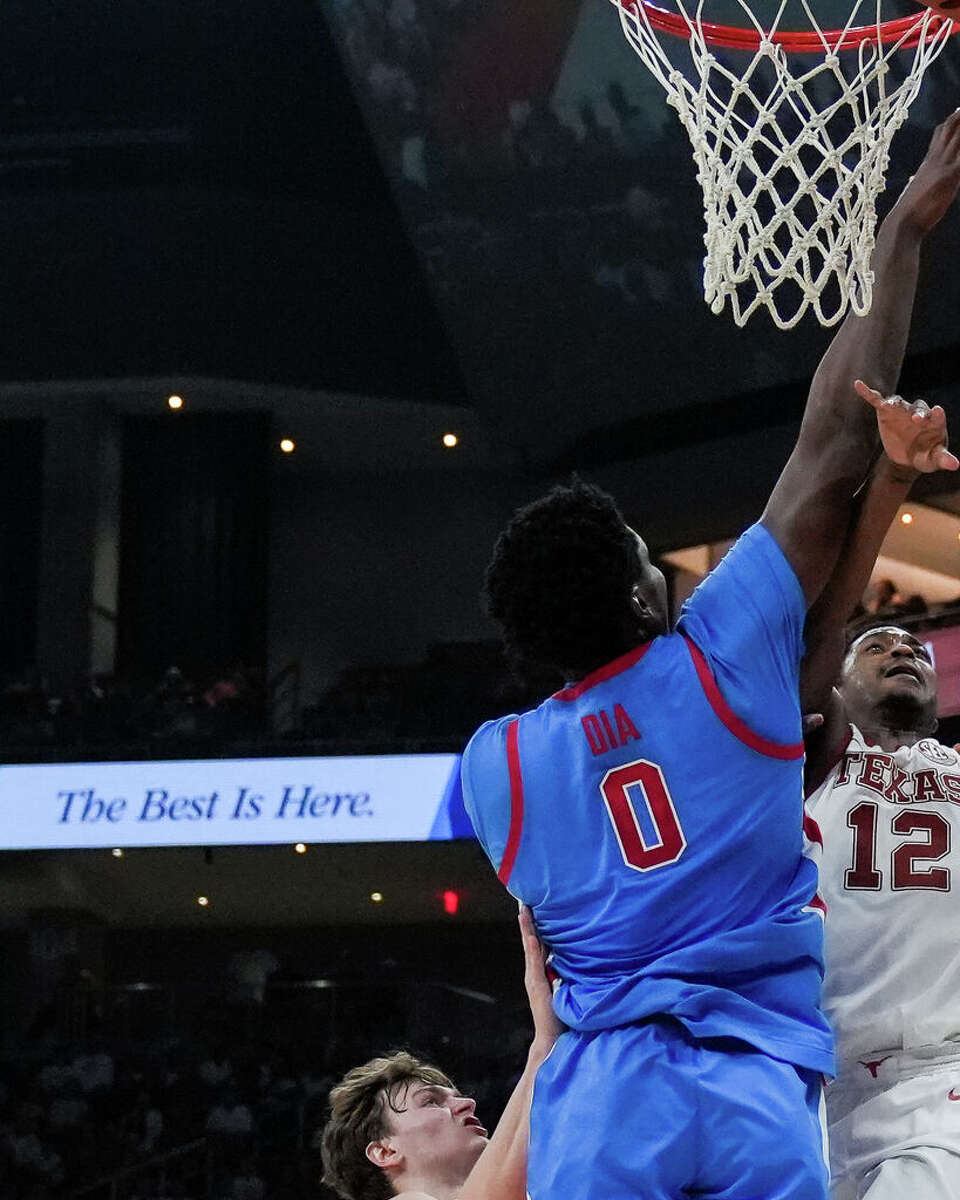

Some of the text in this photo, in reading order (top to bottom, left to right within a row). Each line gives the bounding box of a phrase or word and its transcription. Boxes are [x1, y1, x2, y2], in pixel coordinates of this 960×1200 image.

[581, 703, 642, 757] DIA
[57, 785, 374, 823] The Best Is Here.
[599, 758, 687, 873] 0
[844, 801, 951, 892] 12
